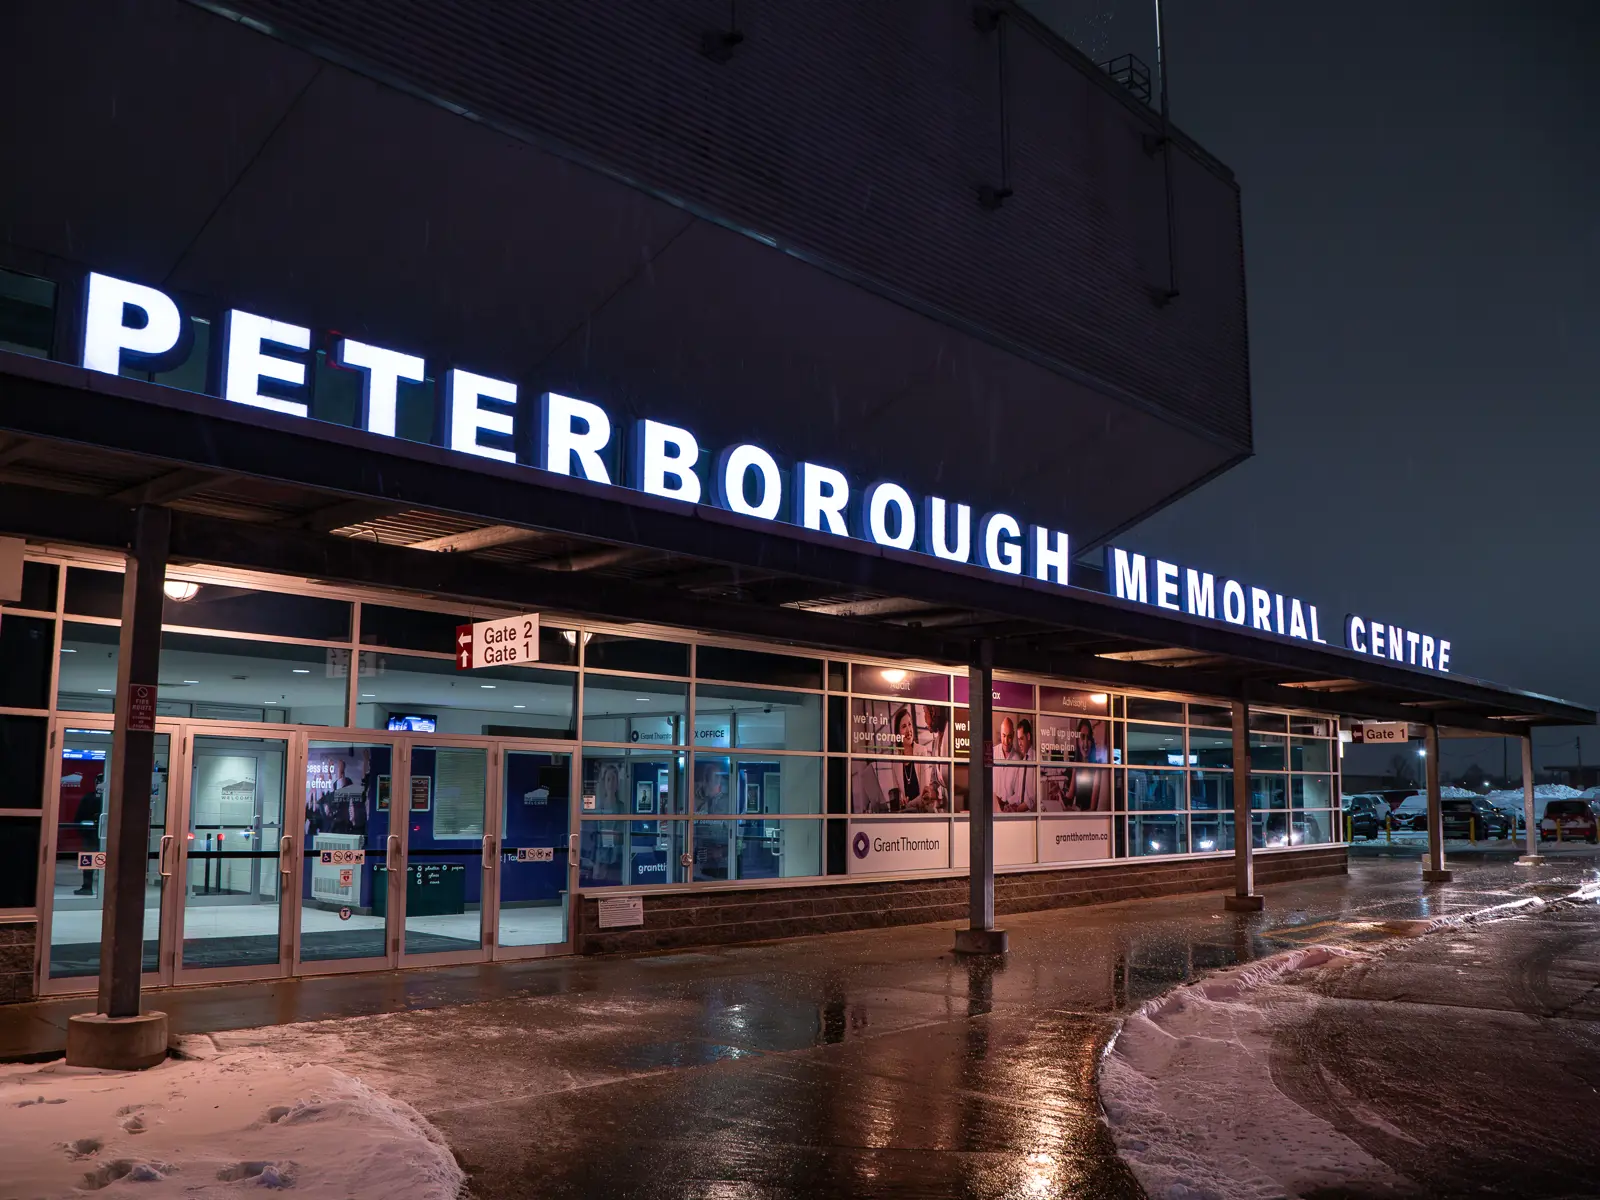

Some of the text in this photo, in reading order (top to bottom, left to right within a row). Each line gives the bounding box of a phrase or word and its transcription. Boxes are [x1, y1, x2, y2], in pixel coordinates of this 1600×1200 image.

[82, 271, 1451, 673] PETERBOROUGH MEMORIAL CENTRE
[484, 620, 532, 644] Gate 2
[484, 641, 529, 664] Gate 1
[992, 688, 1001, 700] ax
[1062, 696, 1087, 710] Advisory
[853, 712, 888, 726] we're in
[955, 722, 966, 732] we
[1040, 726, 1081, 741] we'll up your
[700, 729, 725, 739] OFFICE
[853, 731, 906, 744] your corner
[1366, 728, 1405, 740] Gate 1
[1040, 742, 1075, 754] game plan
[322, 761, 328, 773] is
[311, 777, 332, 789] effort
[873, 836, 940, 853] Grant Thornton
[1055, 831, 1108, 845] grantthornton.ca
